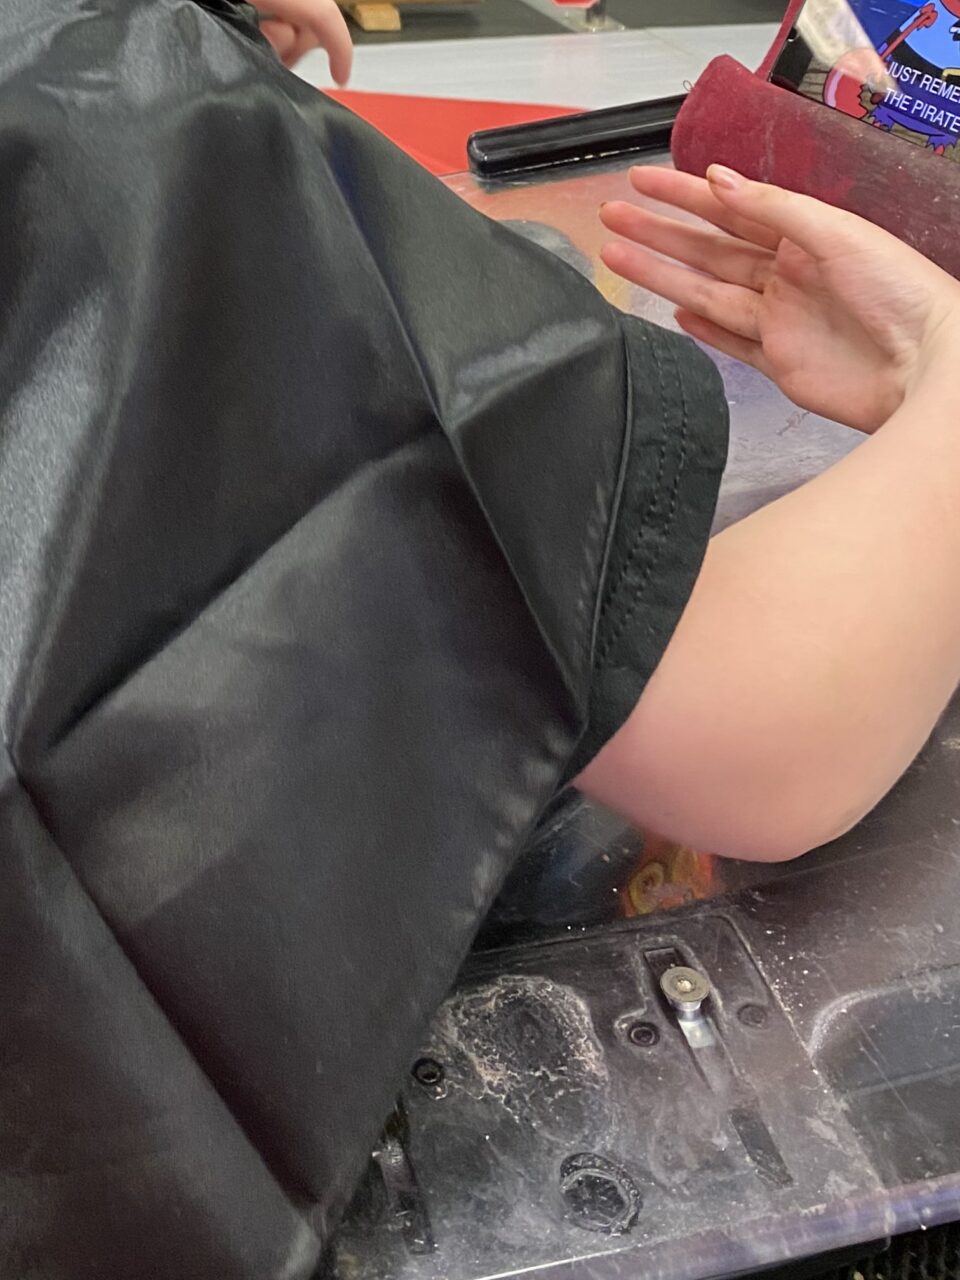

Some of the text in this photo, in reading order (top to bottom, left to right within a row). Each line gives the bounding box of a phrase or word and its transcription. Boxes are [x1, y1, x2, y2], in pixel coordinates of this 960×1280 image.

[885, 61, 960, 104] JUST REME
[884, 87, 960, 133] THE PIRATE
